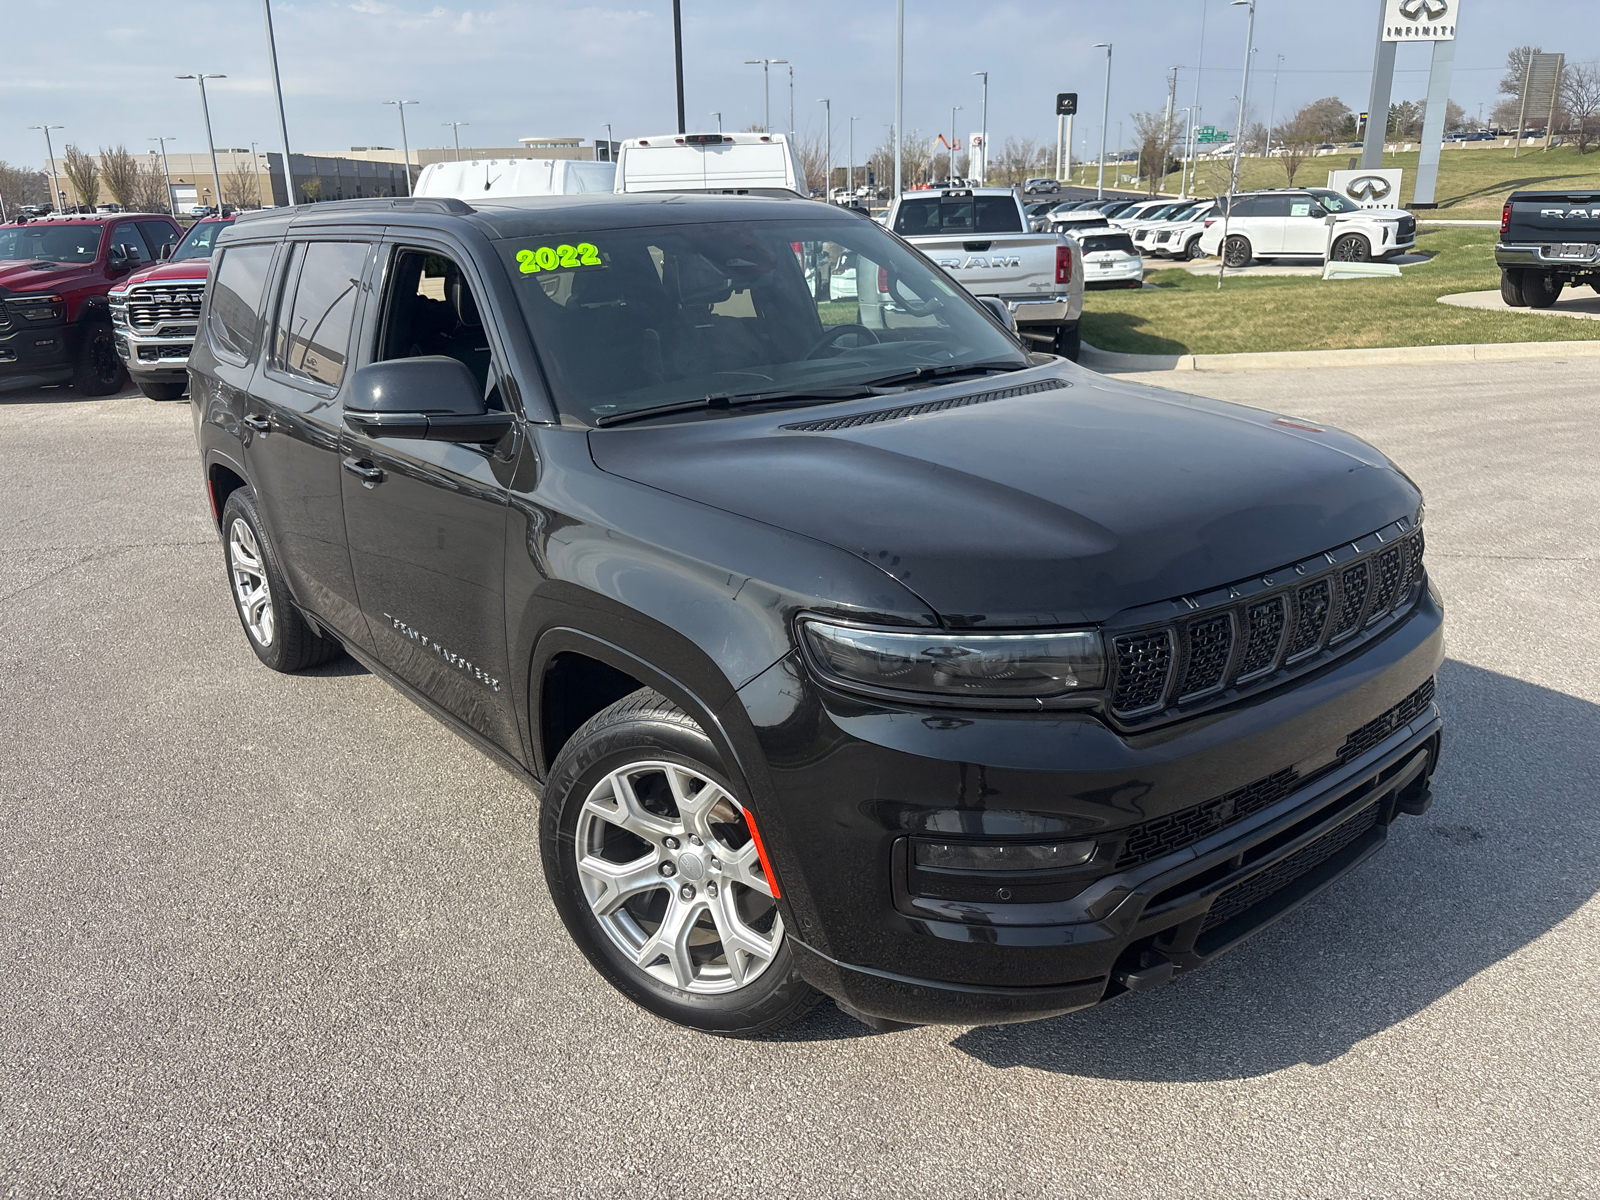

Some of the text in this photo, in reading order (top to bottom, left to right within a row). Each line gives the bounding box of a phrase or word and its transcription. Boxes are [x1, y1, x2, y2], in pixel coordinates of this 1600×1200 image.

[1387, 25, 1455, 37] INFINITI
[515, 242, 602, 274] 2022
[935, 255, 1021, 270] RAM
[1181, 520, 1409, 609] WAGONEER
